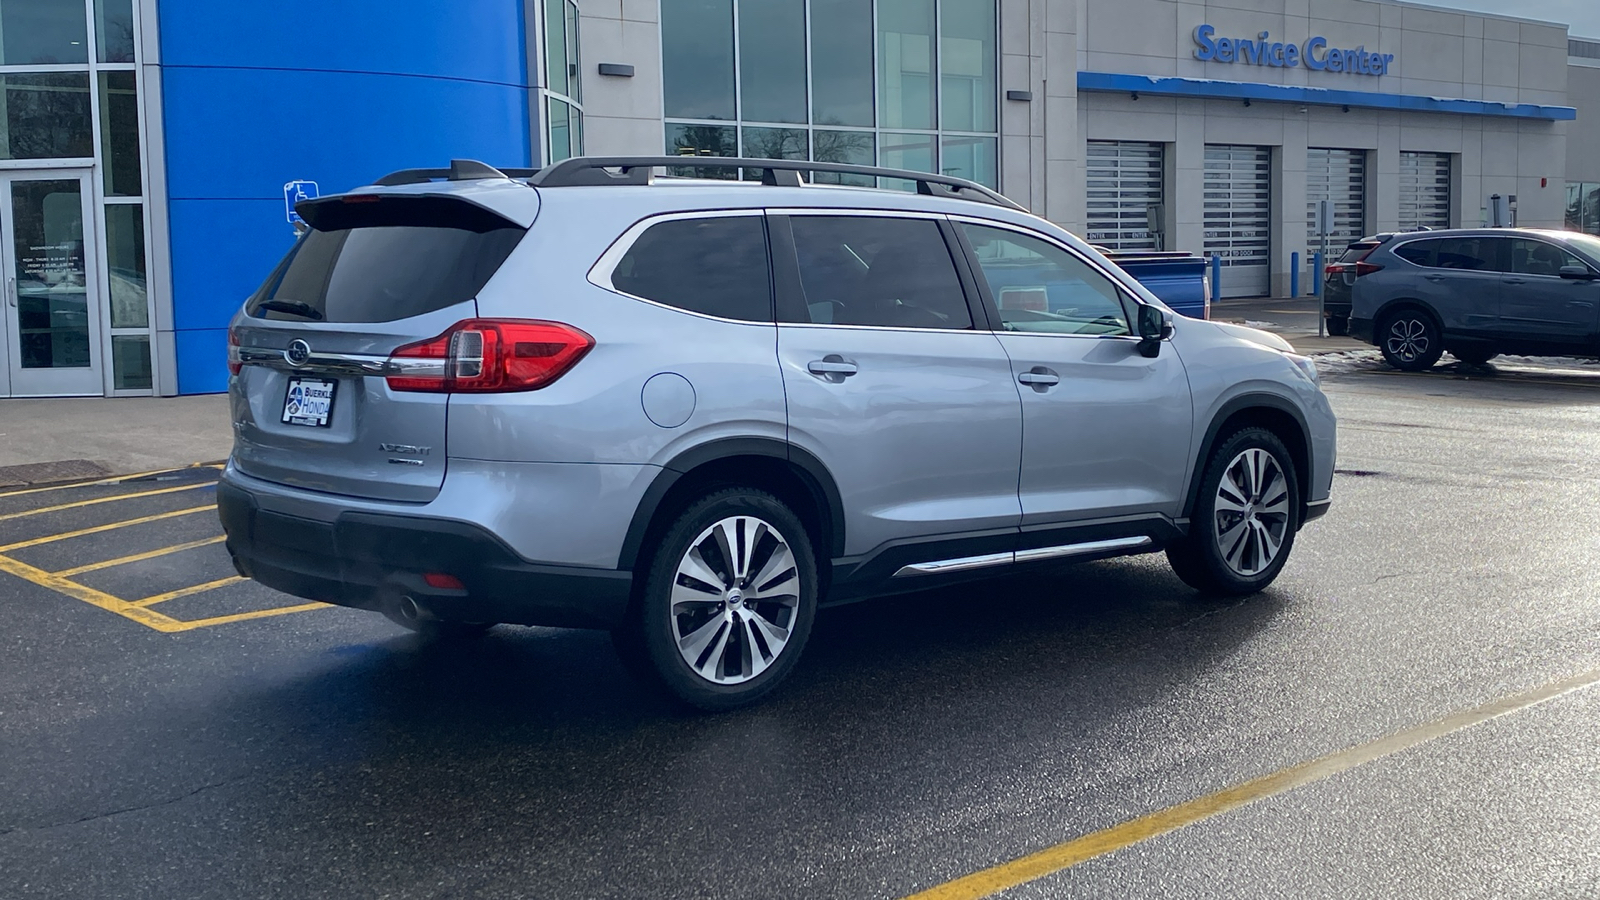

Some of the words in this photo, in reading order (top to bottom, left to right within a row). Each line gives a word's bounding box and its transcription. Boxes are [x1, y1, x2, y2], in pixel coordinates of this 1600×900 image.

[1193, 24, 1299, 68] Service
[1302, 36, 1394, 75] Center
[305, 386, 333, 398] BUERKLE
[302, 397, 330, 415] HONDA
[379, 443, 431, 455] ASCENT
